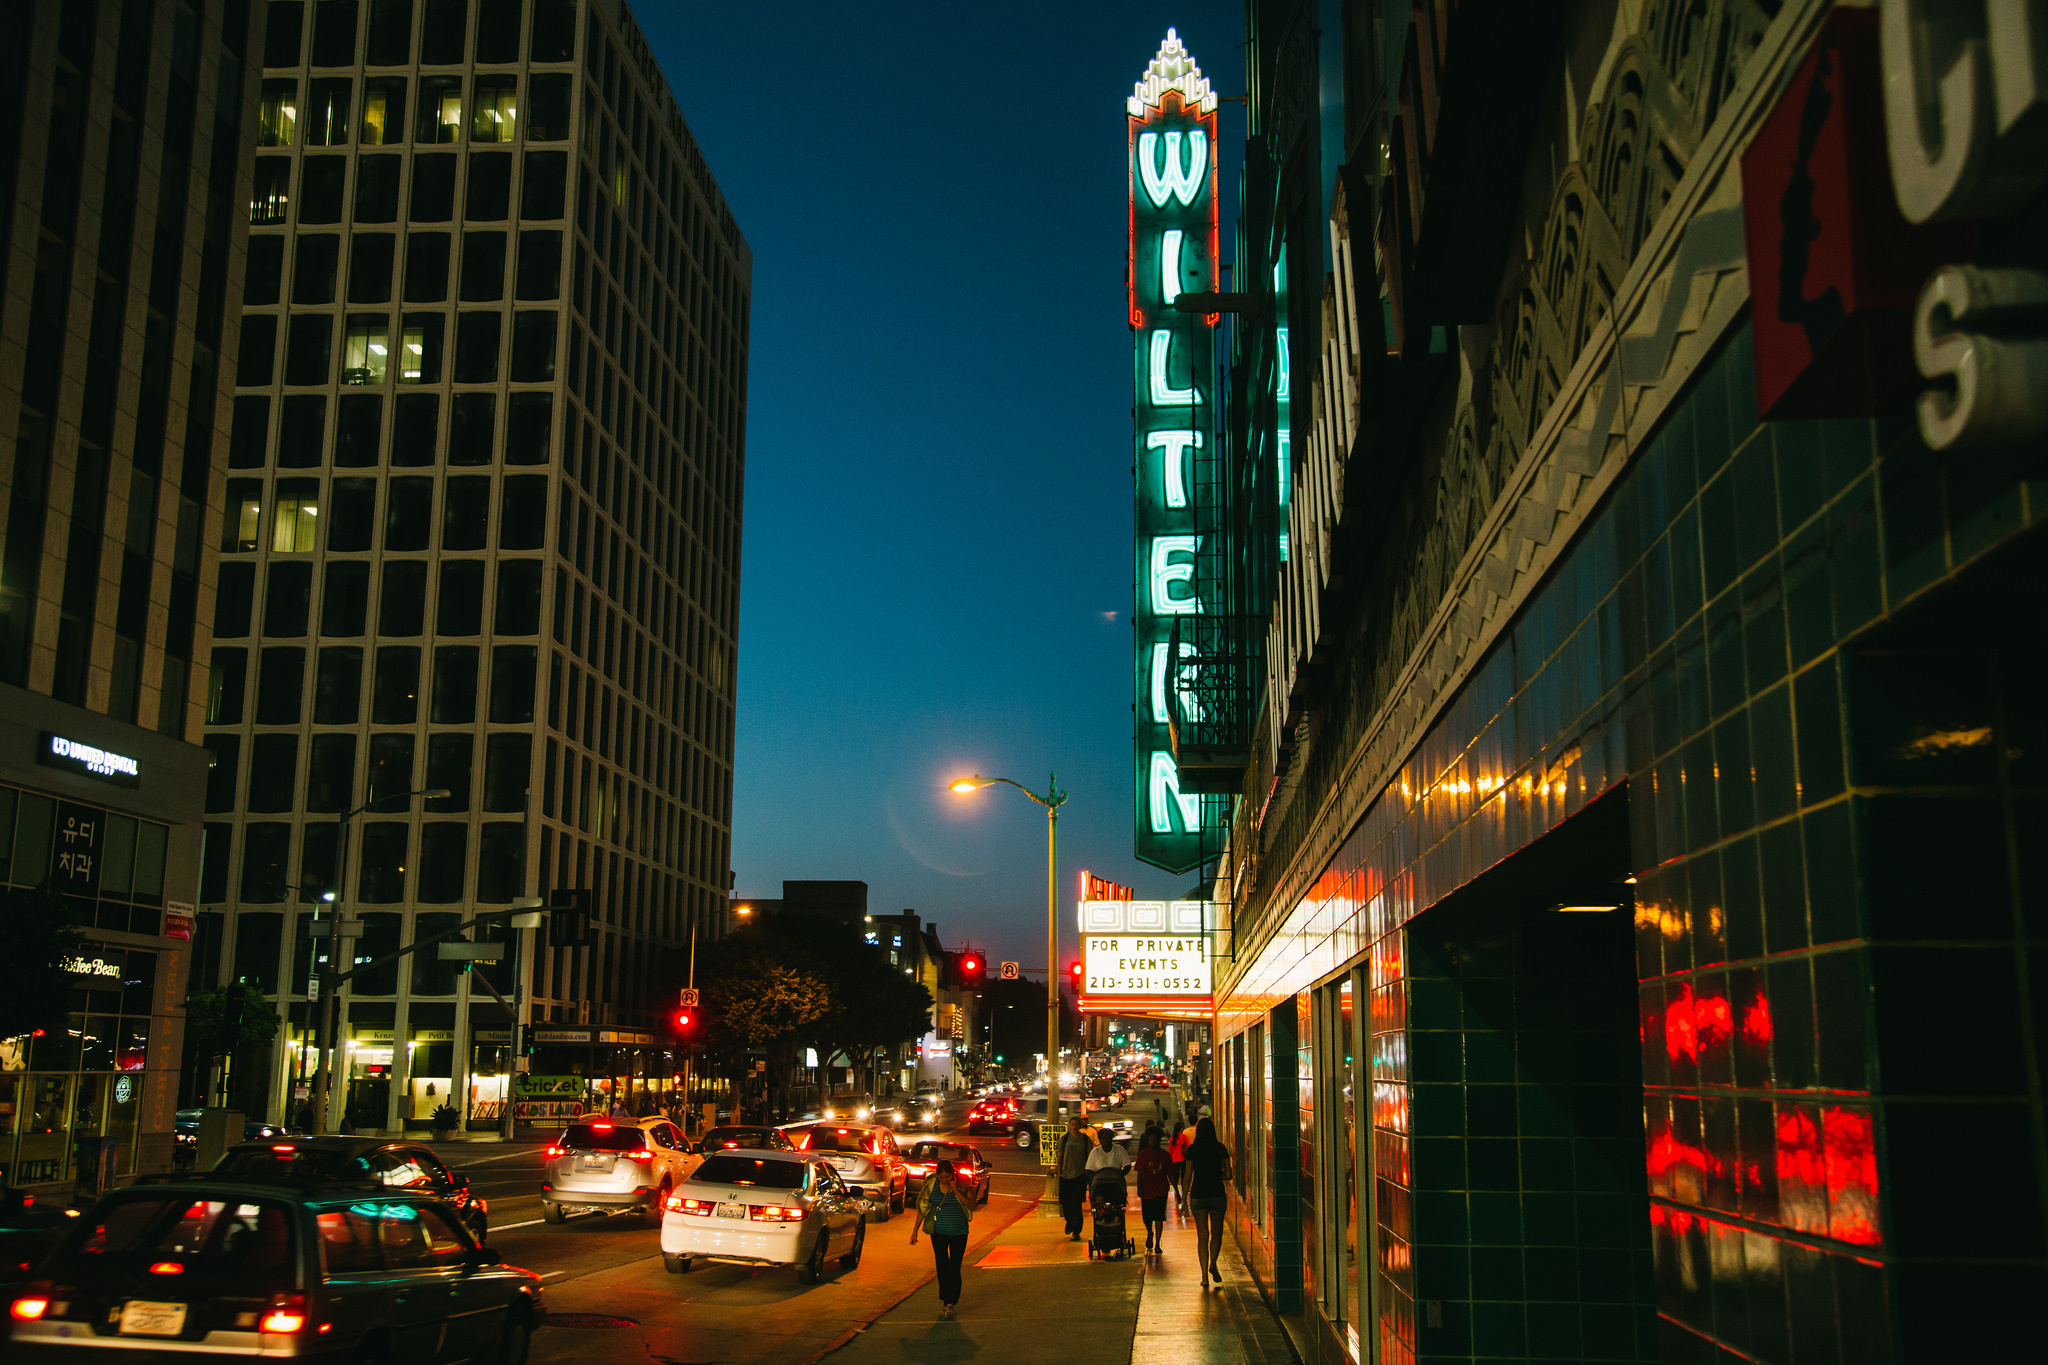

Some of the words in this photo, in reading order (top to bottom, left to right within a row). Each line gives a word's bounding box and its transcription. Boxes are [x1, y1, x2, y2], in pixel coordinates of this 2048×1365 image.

[1138, 129, 1208, 834] WILTERN
[70, 741, 105, 765] UNITED
[104, 751, 138, 776] DENTAL
[62, 816, 95, 848] 유디
[59, 851, 93, 882] 치과
[1092, 940, 1118, 951] FOR
[1136, 940, 1203, 951] PRIVATE
[92, 958, 121, 979] Bean
[1119, 958, 1178, 970] EVENTS
[153, 1044, 170, 1130] FARGO
[522, 1078, 578, 1093] cricket
[515, 1102, 547, 1118] KIDS
[549, 1102, 583, 1117] LAND
